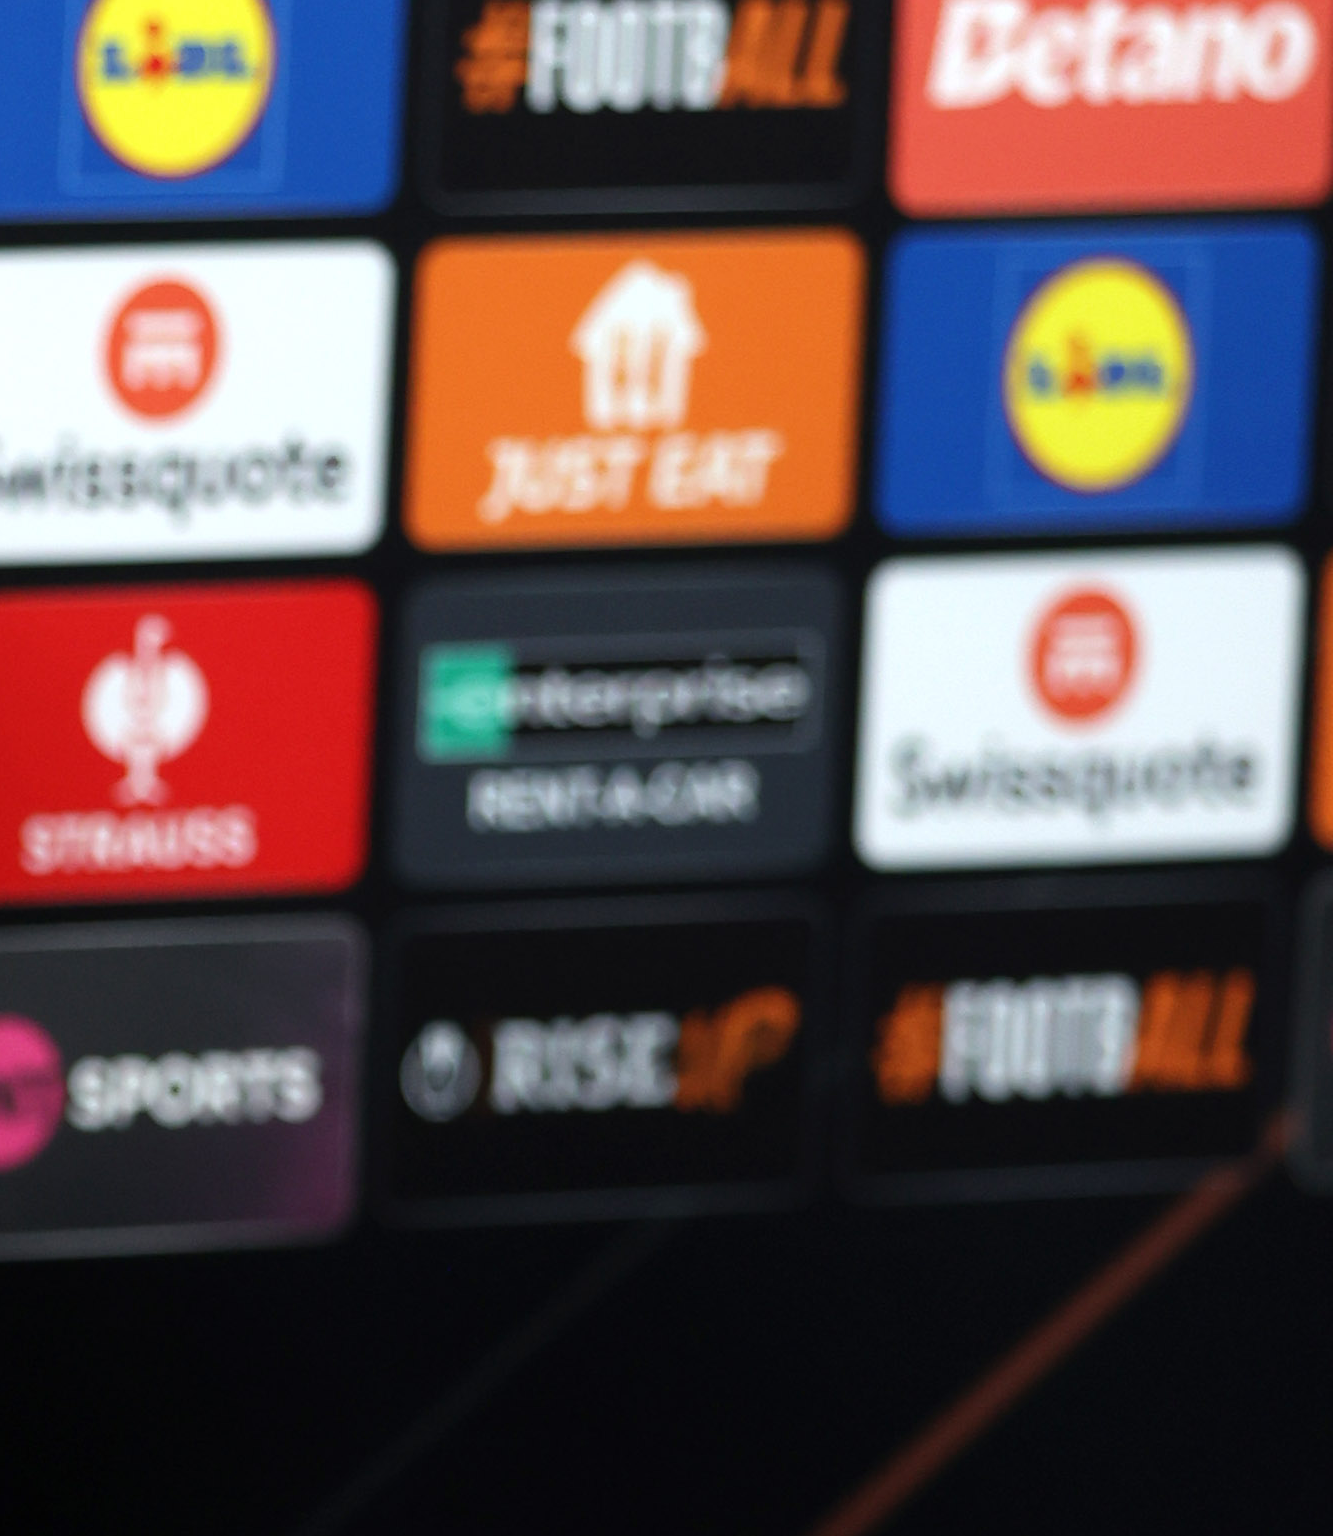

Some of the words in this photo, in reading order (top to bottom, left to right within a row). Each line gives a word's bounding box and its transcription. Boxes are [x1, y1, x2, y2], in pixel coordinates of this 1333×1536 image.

[479, 436, 647, 524] JUST
[646, 429, 783, 510] EAT
[888, 729, 1263, 824] Swissquote
[19, 805, 258, 874] STRAUSS
[66, 1046, 322, 1132] SPORTS
